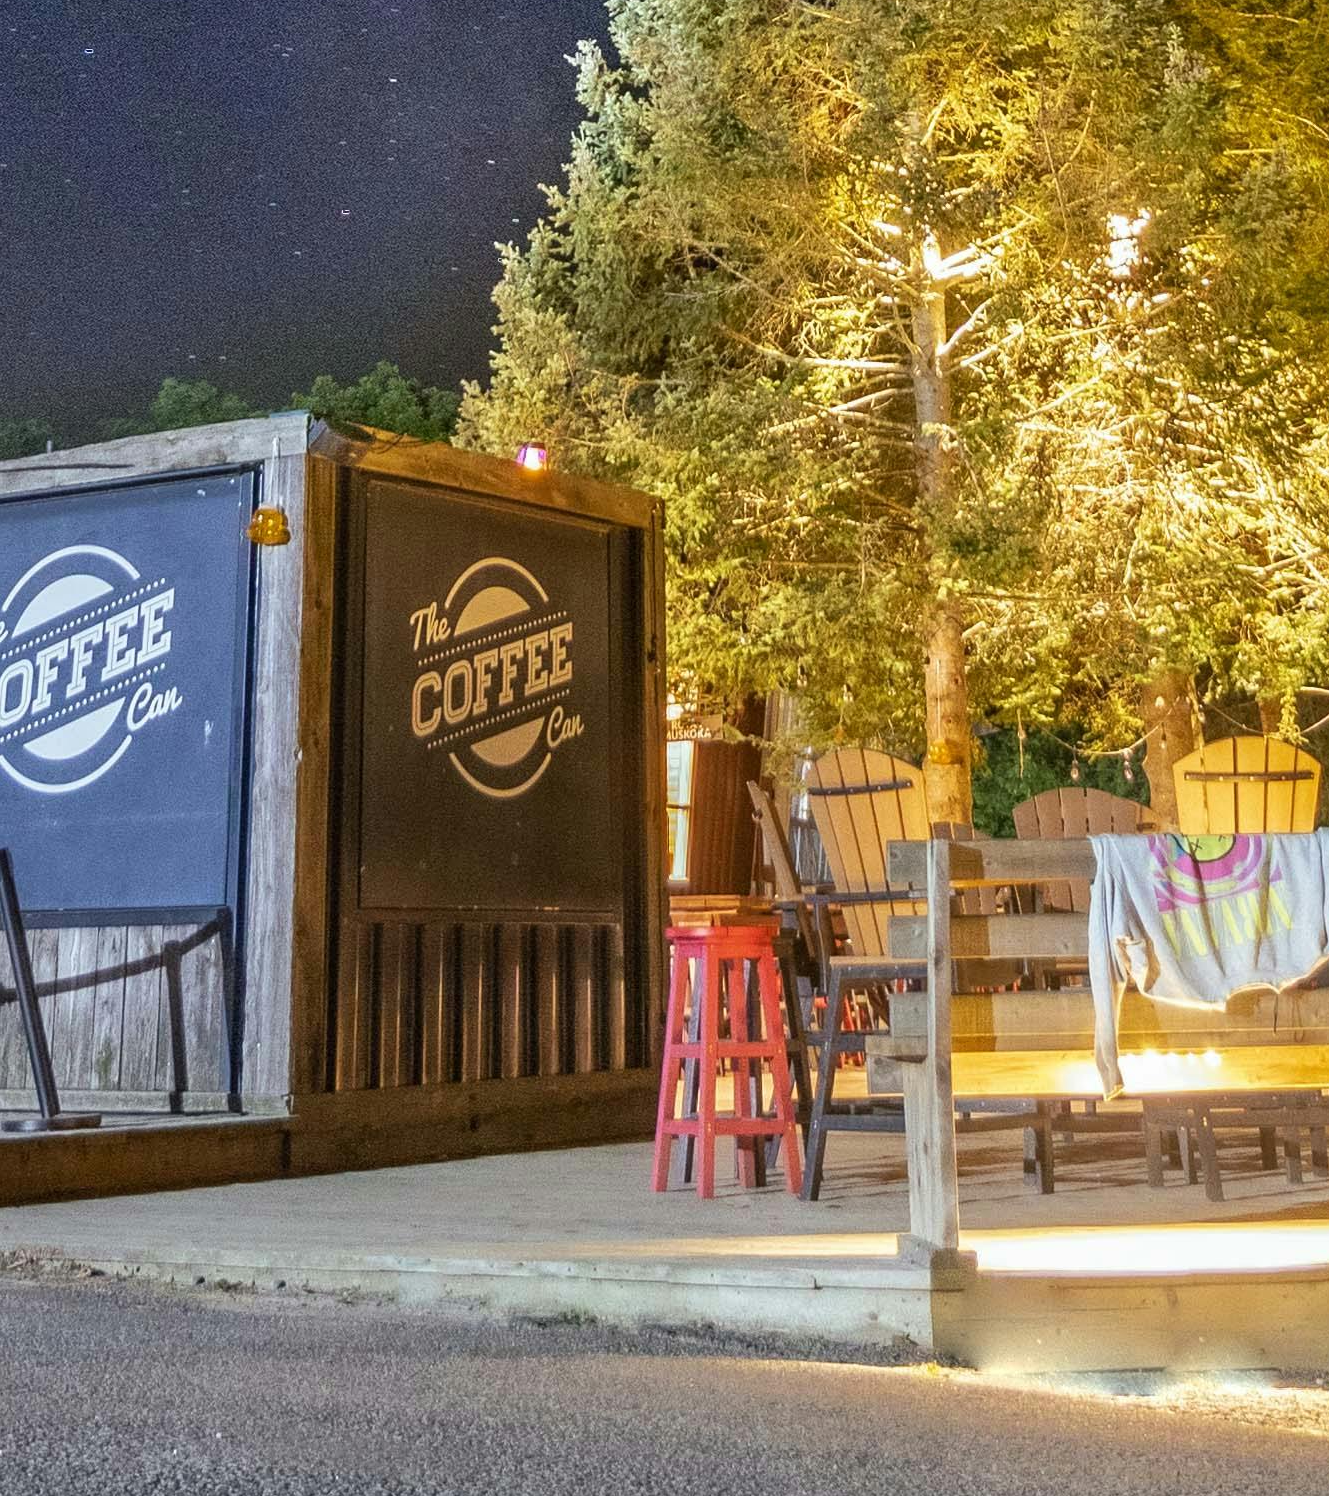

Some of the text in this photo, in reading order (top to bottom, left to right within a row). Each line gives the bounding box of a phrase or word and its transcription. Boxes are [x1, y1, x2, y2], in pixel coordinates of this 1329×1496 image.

[409, 601, 452, 651] The
[411, 621, 574, 738] COFFEE
[126, 681, 184, 732] Can
[546, 705, 585, 749] Can
